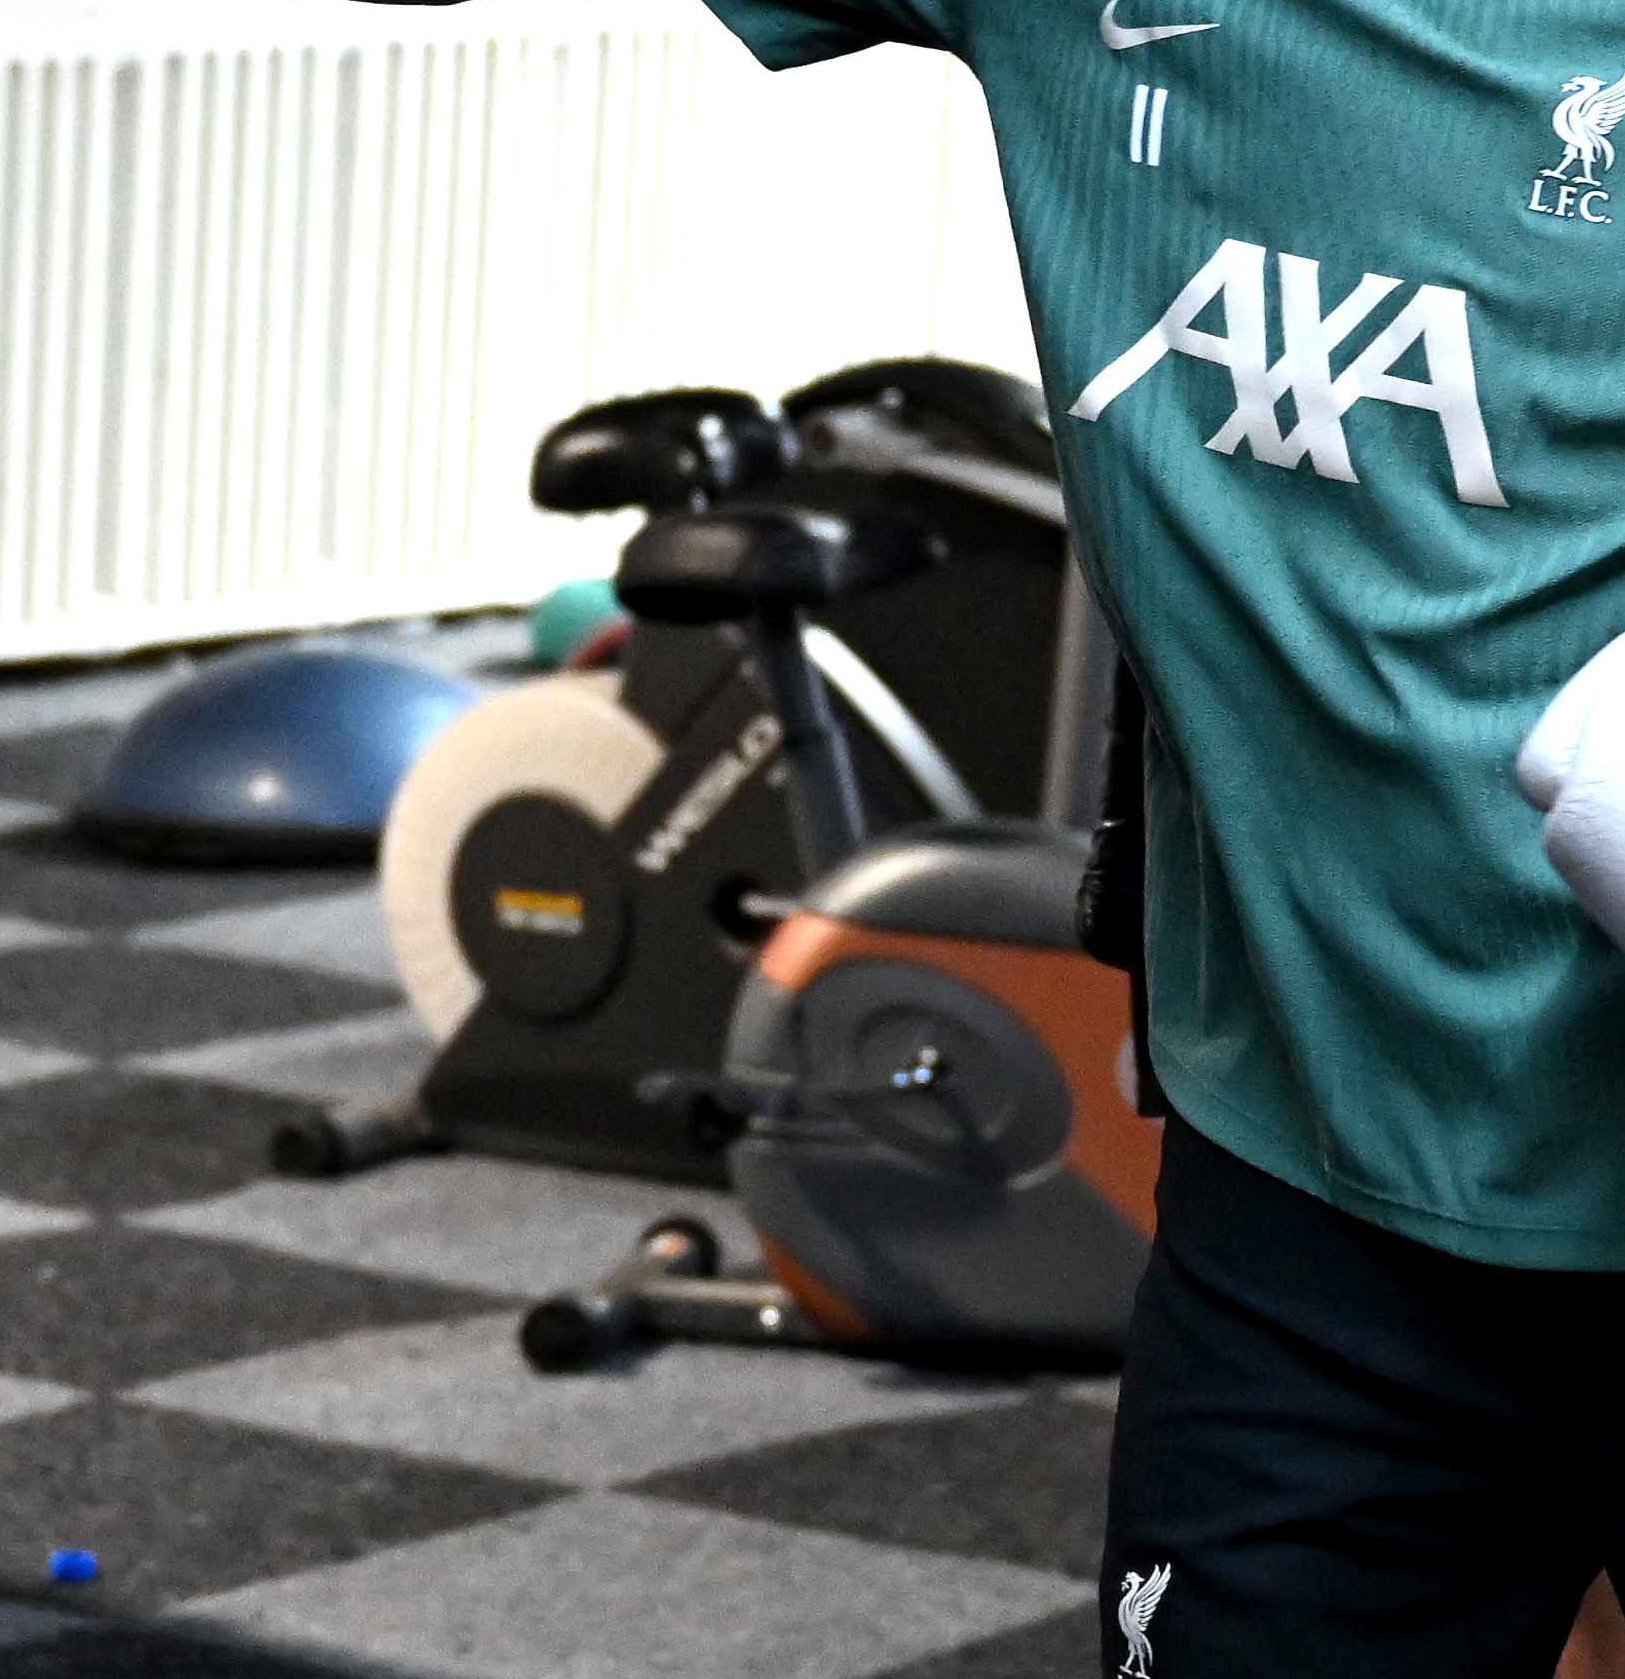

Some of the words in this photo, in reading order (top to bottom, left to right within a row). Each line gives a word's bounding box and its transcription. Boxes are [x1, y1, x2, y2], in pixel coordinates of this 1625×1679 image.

[1129, 84, 1169, 167] 11
[1527, 178, 1613, 224] L.F.C.
[1067, 238, 1511, 508] AXA
